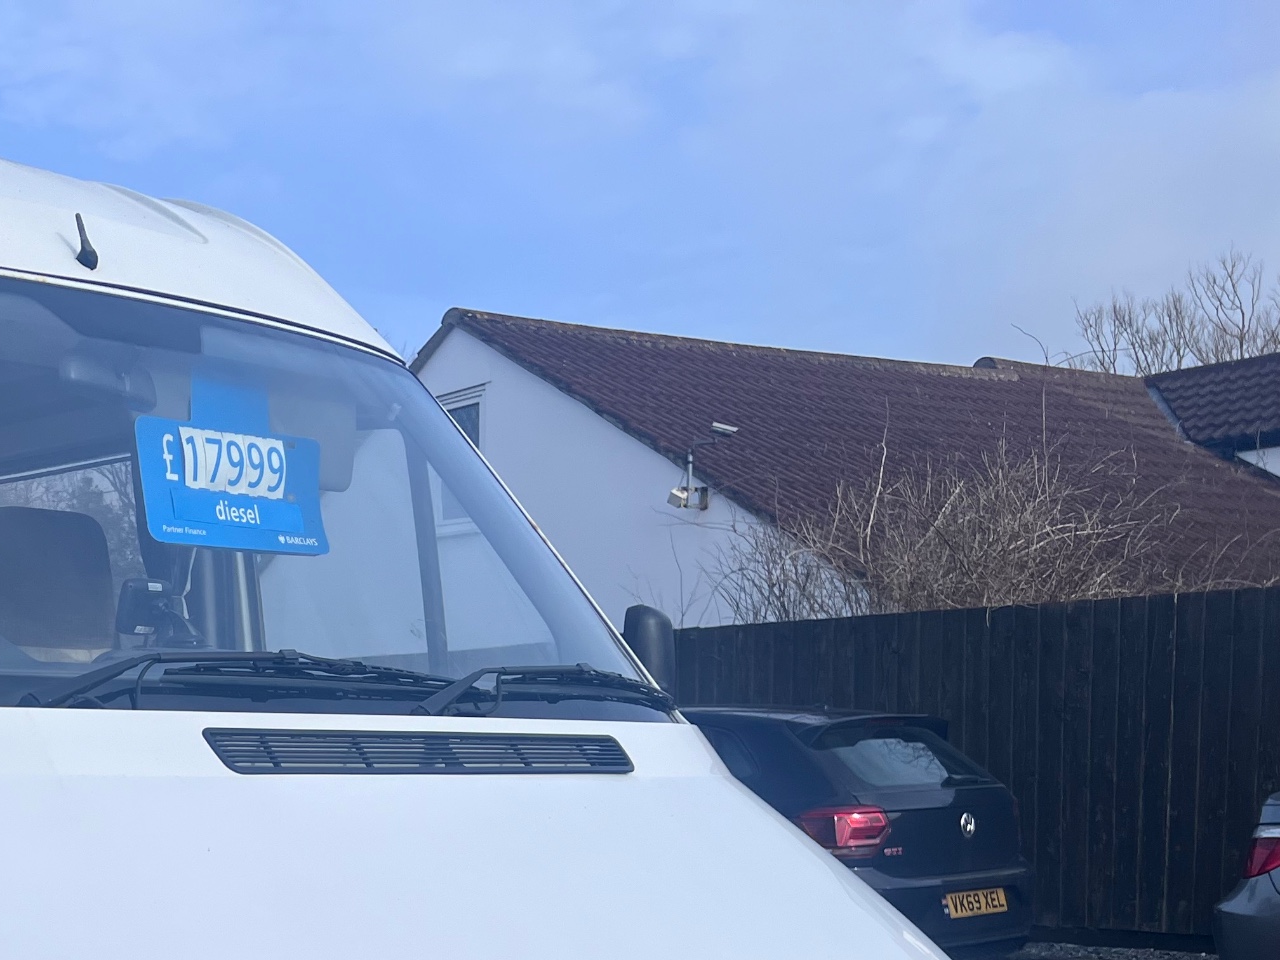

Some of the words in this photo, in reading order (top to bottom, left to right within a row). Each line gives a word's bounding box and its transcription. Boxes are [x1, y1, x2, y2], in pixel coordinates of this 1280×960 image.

[162, 433, 285, 493] £17999
[215, 500, 261, 525] diesel
[162, 525, 184, 534] Partner
[184, 526, 207, 536] Finance
[286, 535, 319, 546] BARCLAYS
[883, 846, 903, 857] GTI
[950, 892, 982, 914] VK69
[981, 889, 1005, 910] XEL
